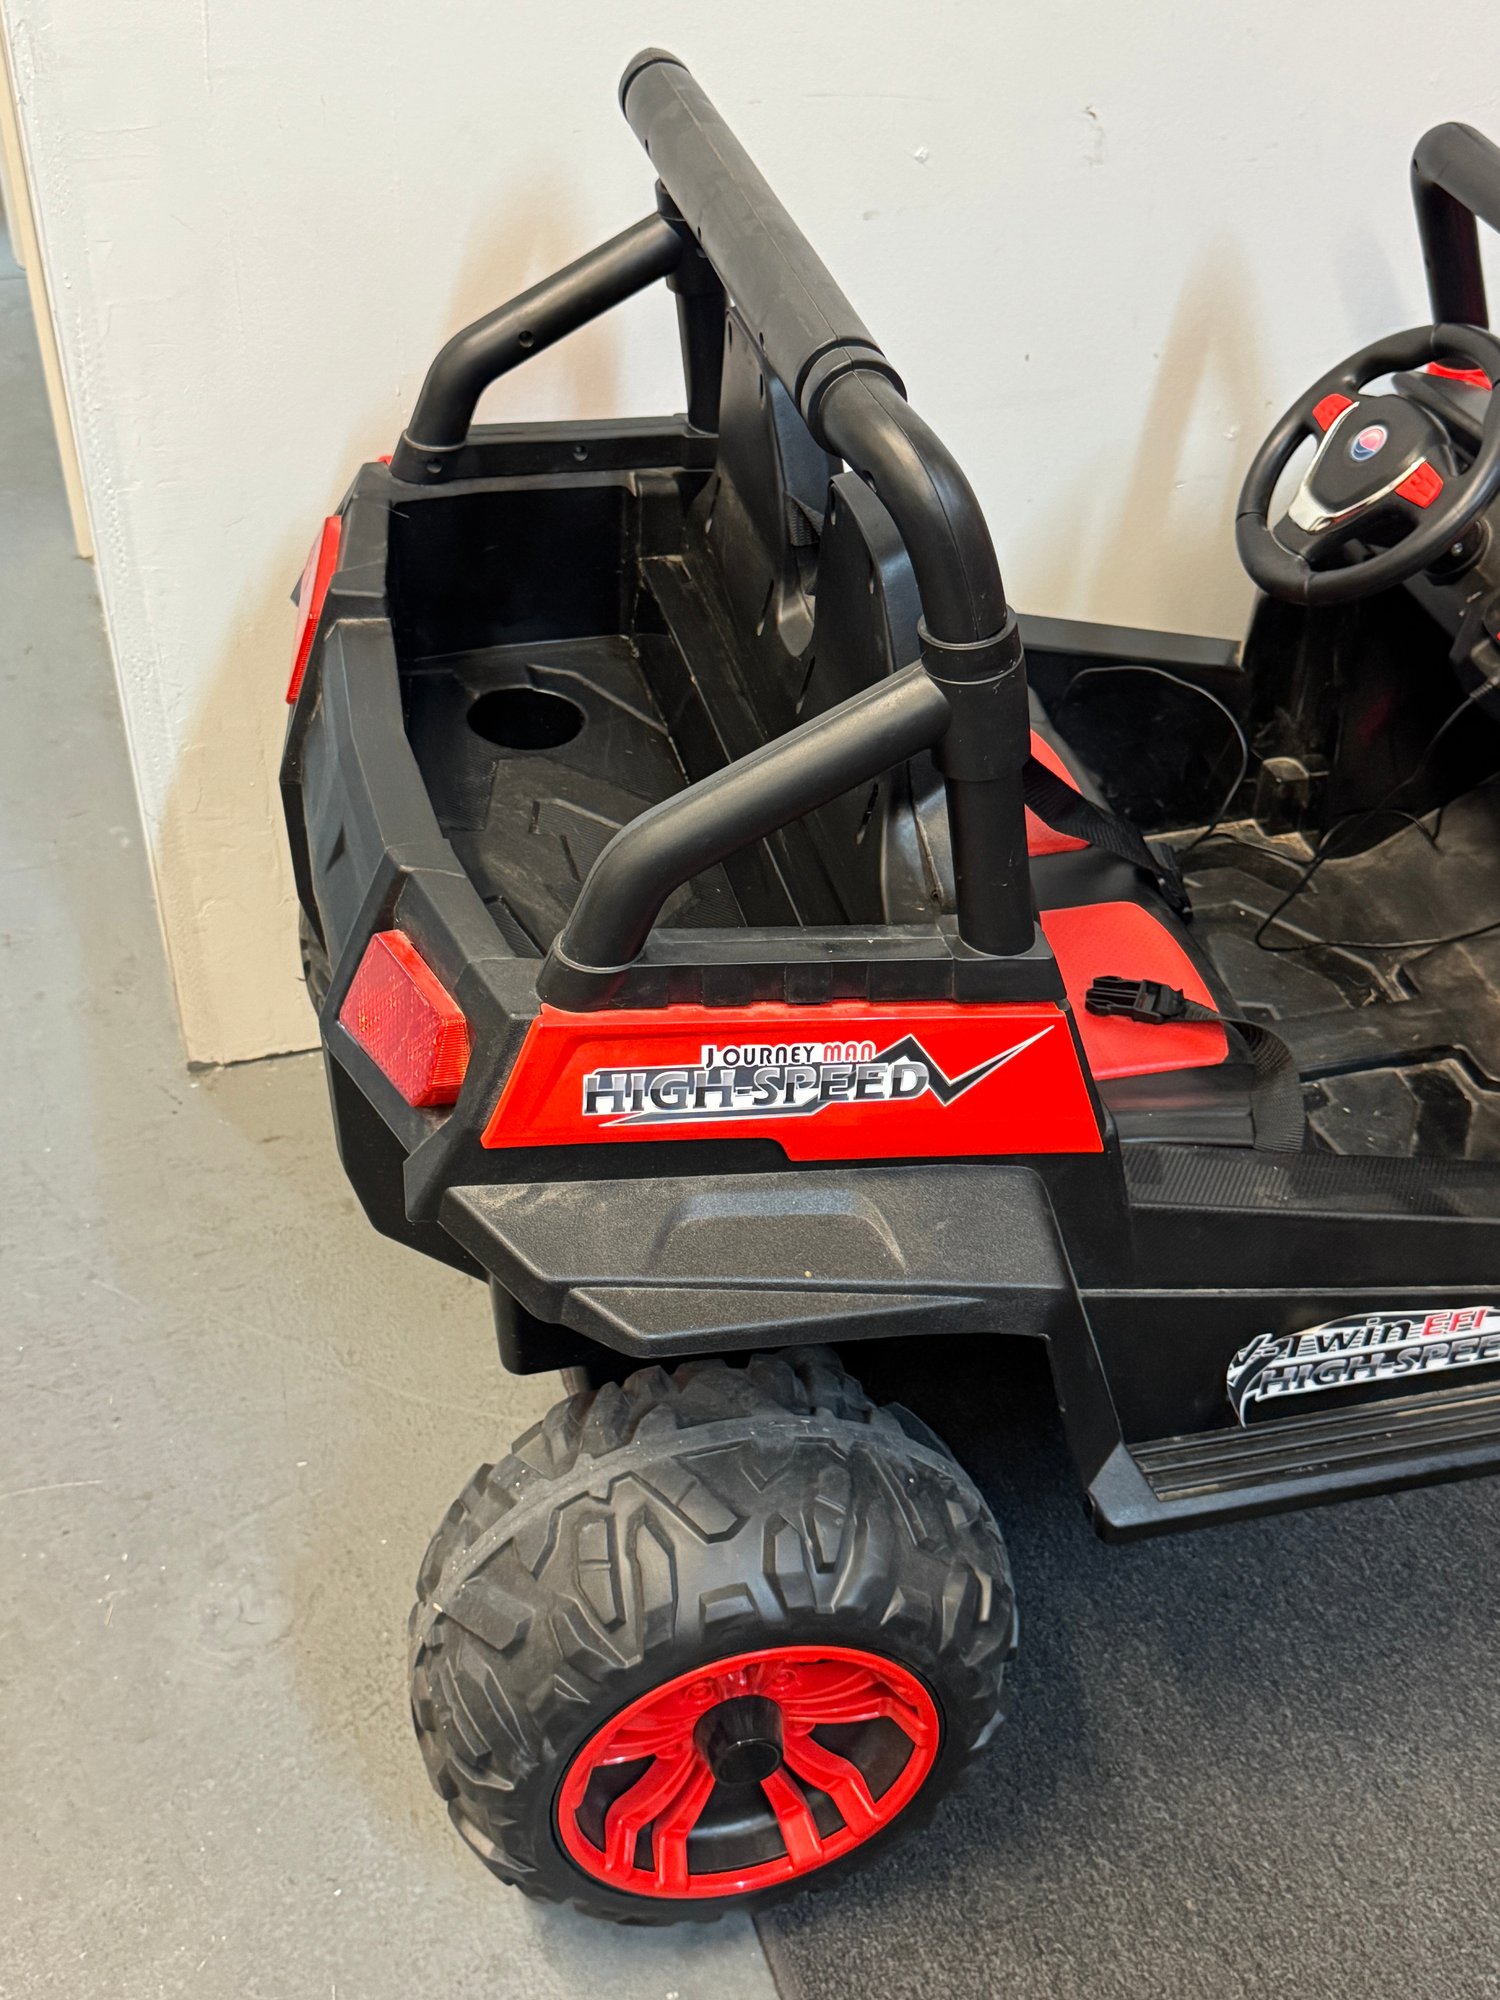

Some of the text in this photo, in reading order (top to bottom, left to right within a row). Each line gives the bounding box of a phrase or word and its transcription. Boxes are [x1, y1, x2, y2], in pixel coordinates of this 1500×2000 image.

[705, 1042, 873, 1069] JOURNEY MAN
[583, 1061, 929, 1113] HIGH-SPEED
[1421, 1309, 1487, 1336] EFI
